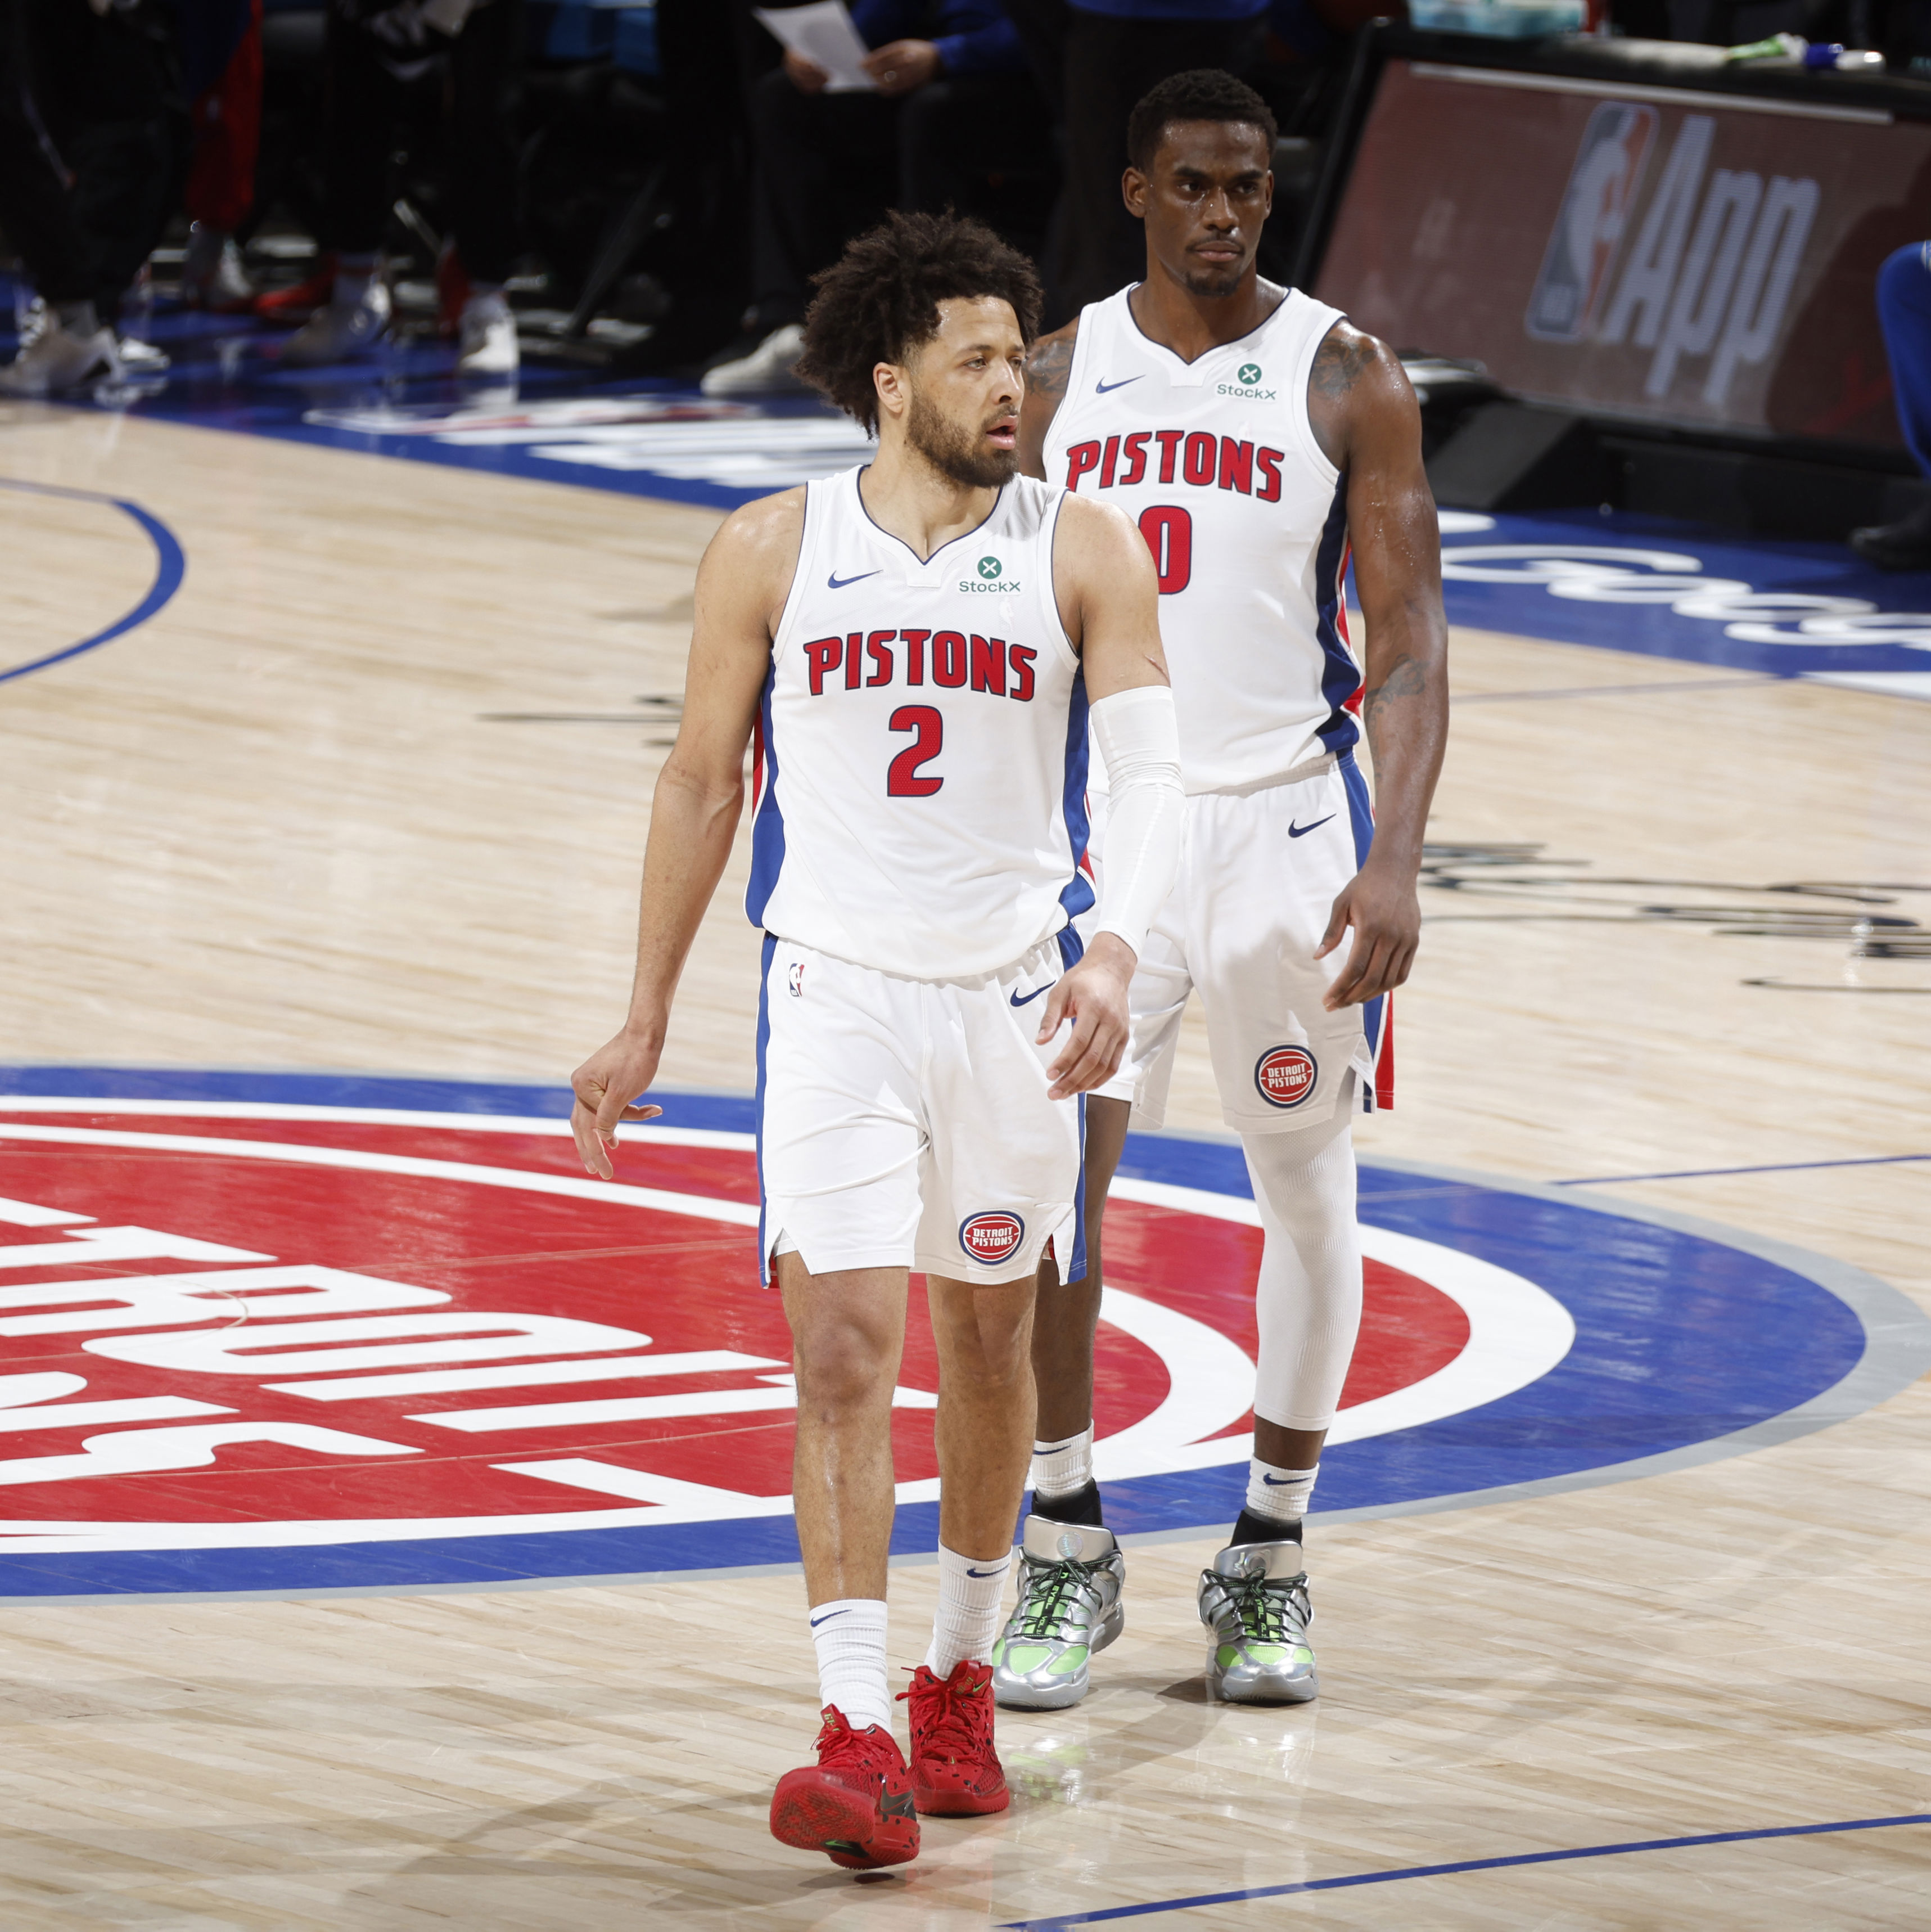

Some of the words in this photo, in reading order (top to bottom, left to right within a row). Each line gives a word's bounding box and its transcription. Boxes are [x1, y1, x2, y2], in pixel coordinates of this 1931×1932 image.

[1601, 114, 1821, 404] App
[1217, 384, 1276, 400] StockX
[1066, 430, 1285, 503] PISTONS
[1138, 505, 1192, 595] 0
[959, 581, 1021, 592] StockX
[1440, 544, 1931, 651] Goog
[803, 629, 1038, 702] PISTONS
[887, 704, 945, 798] 2
[1266, 1062, 1306, 1078] DETROIT
[1267, 1073, 1307, 1088] PISTONS
[972, 1226, 1013, 1238] DETROIT
[972, 1235, 1013, 1247] PISTONS
[1045, 1585, 1060, 1610] EYBL
